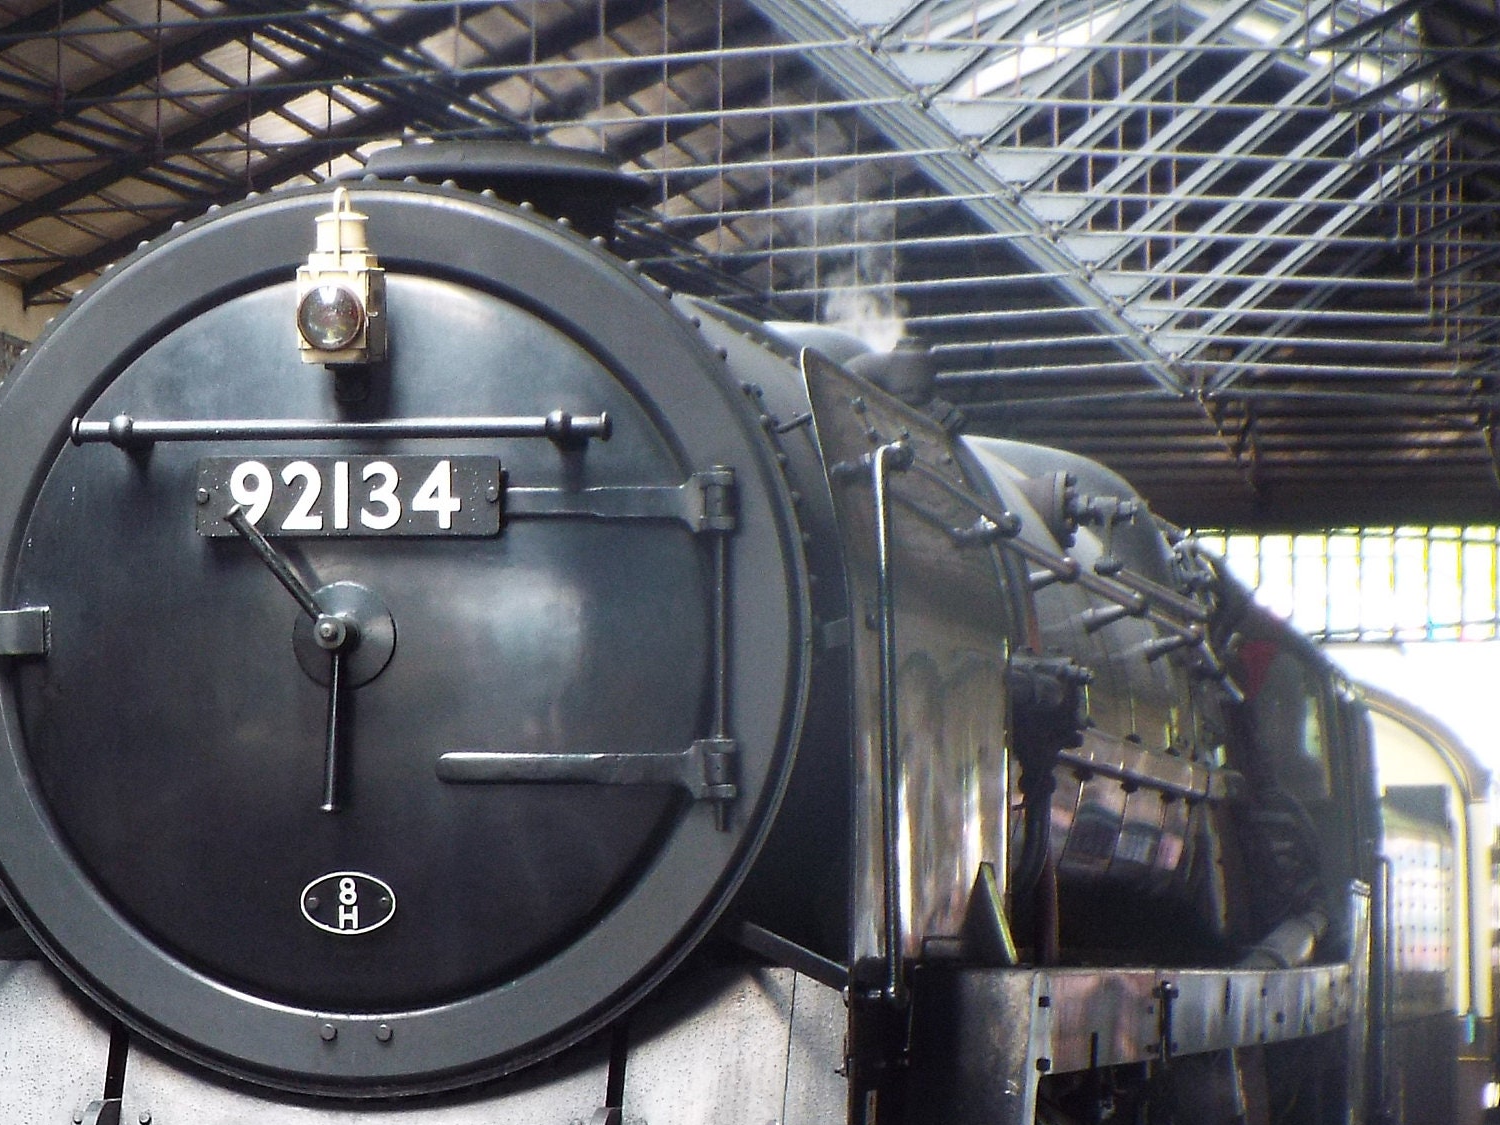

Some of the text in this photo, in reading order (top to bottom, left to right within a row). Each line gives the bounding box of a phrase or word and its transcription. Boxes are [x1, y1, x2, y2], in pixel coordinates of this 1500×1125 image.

[230, 460, 461, 530] 92134
[339, 877, 357, 905] 8
[338, 905, 358, 929] H
